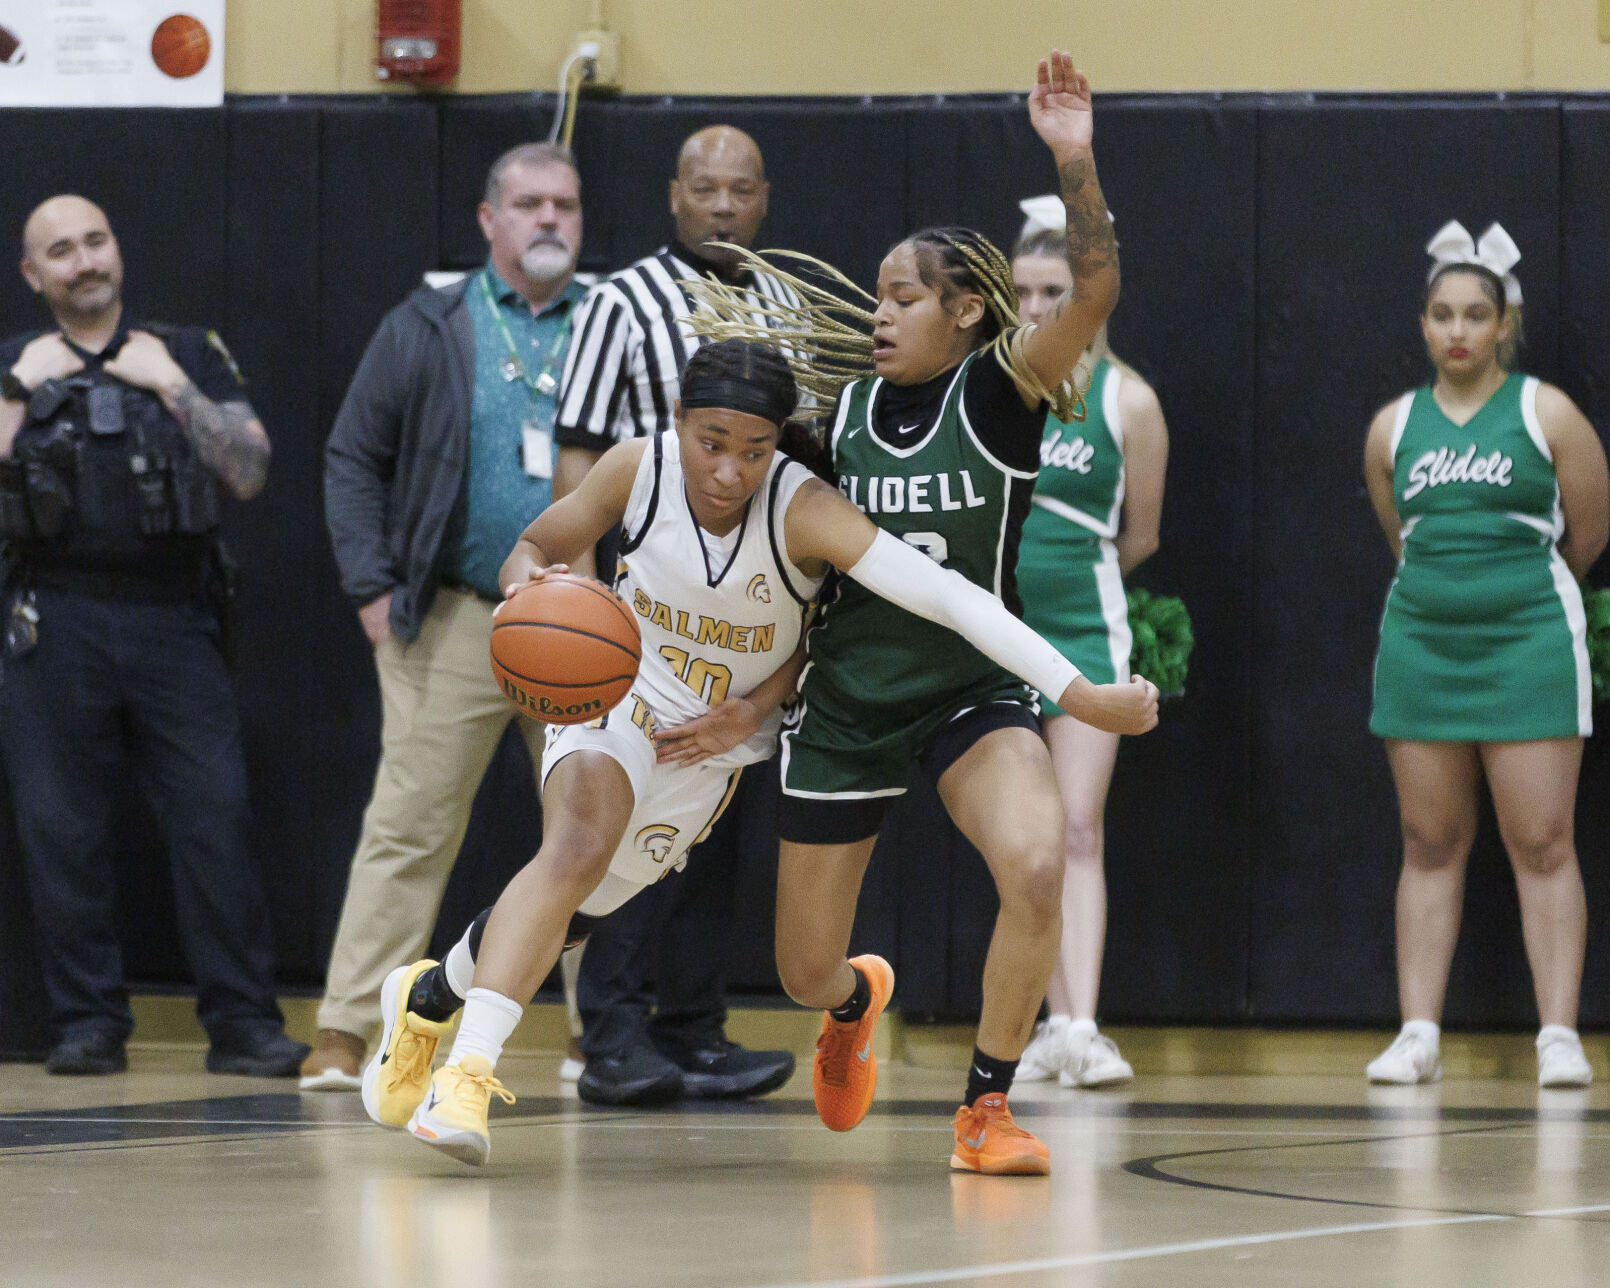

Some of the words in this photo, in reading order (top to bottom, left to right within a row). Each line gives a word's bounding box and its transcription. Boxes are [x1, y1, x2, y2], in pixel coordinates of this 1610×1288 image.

[1402, 443, 1513, 501] Slidell
[633, 587, 776, 653] SALMEN
[502, 676, 602, 717] Wilson
